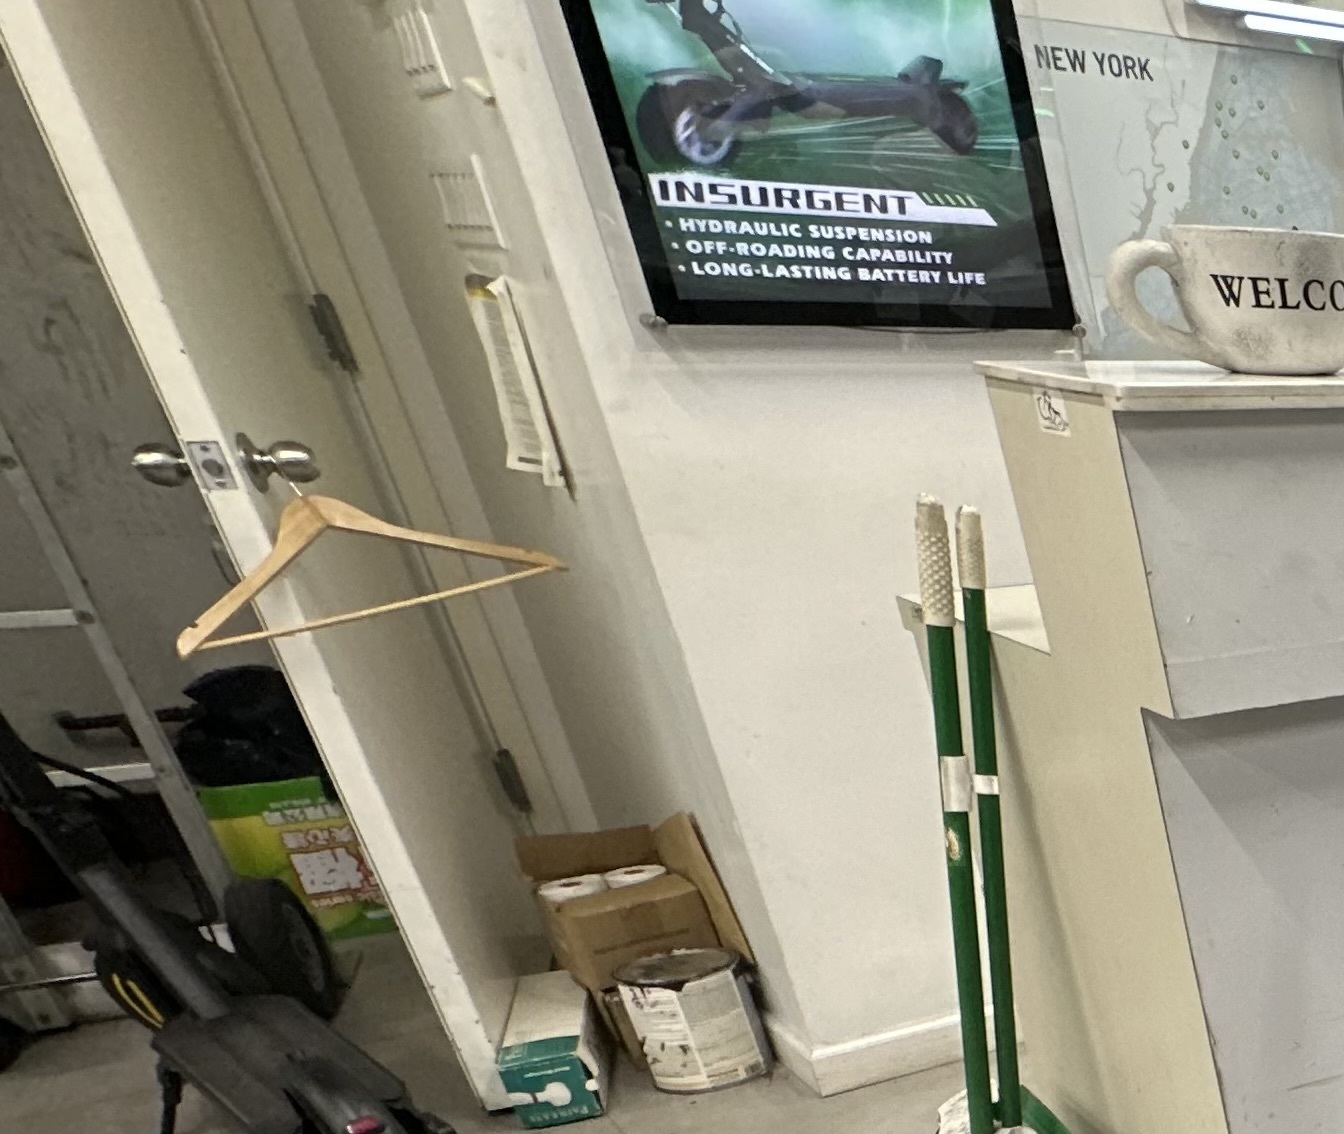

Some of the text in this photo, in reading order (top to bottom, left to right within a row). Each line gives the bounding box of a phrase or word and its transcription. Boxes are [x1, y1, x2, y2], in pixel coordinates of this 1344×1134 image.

[1034, 43, 1154, 82] NEW YORK
[658, 179, 914, 216] INSURGENT
[679, 217, 933, 244] HYDRAULIC SUSPENSION
[686, 239, 953, 266] OFF-ROADING CAPABILITY
[692, 262, 986, 286] LONG-LASTING BATTERY LIFE
